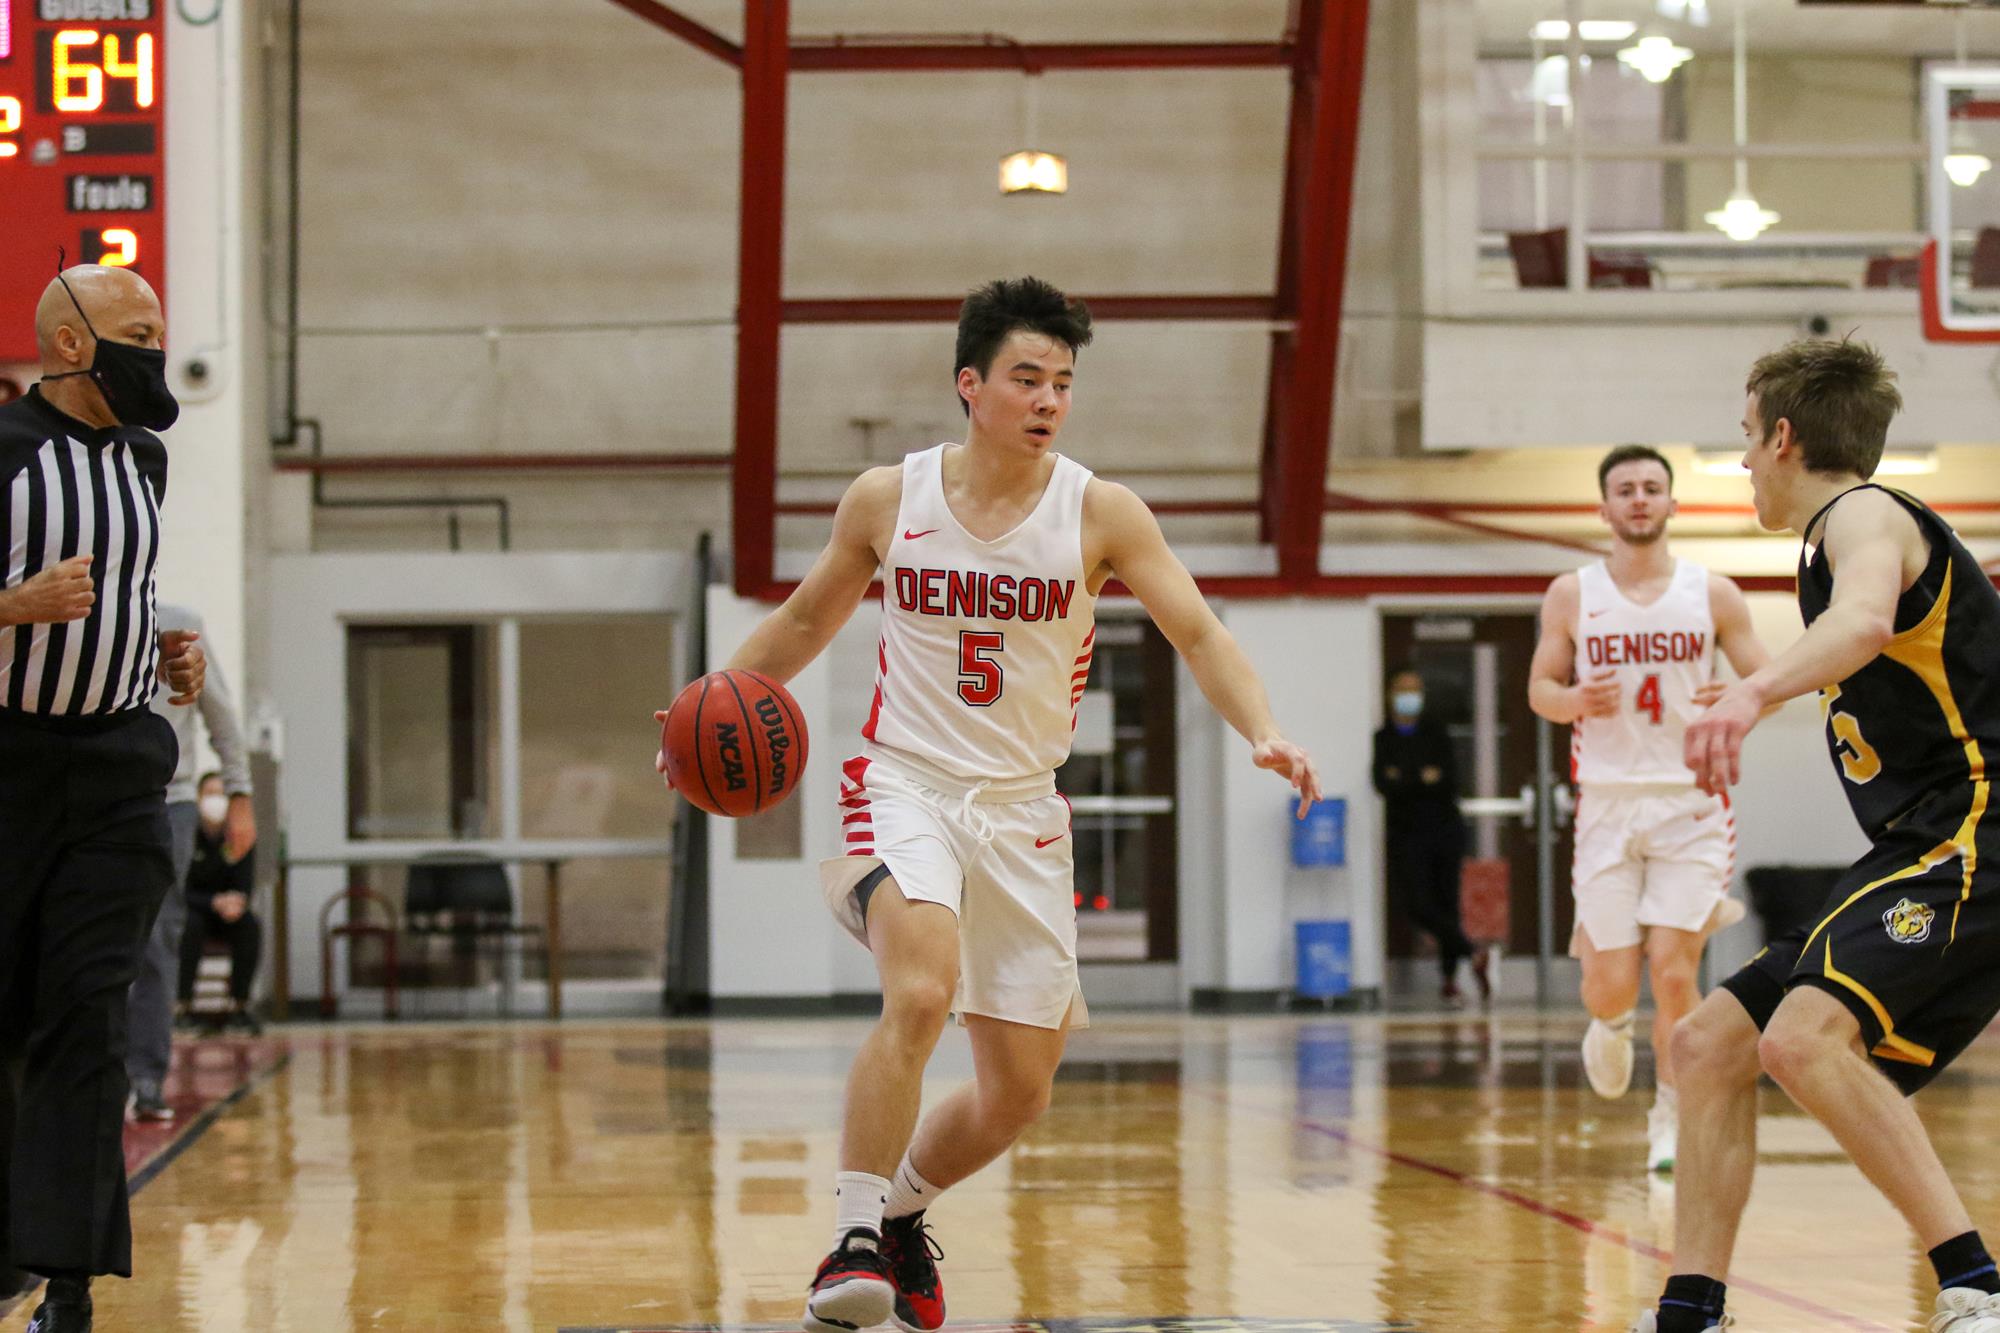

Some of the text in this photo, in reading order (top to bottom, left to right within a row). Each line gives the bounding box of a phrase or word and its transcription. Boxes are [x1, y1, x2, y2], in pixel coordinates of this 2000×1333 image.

[53, 30, 153, 111] 64
[895, 567, 1076, 622] DENISON
[957, 630, 1004, 706] 5
[1586, 631, 1706, 667] DENISON
[1636, 673, 1665, 726] 4
[716, 721, 748, 792] NCAA
[754, 695, 790, 796] Wilson
